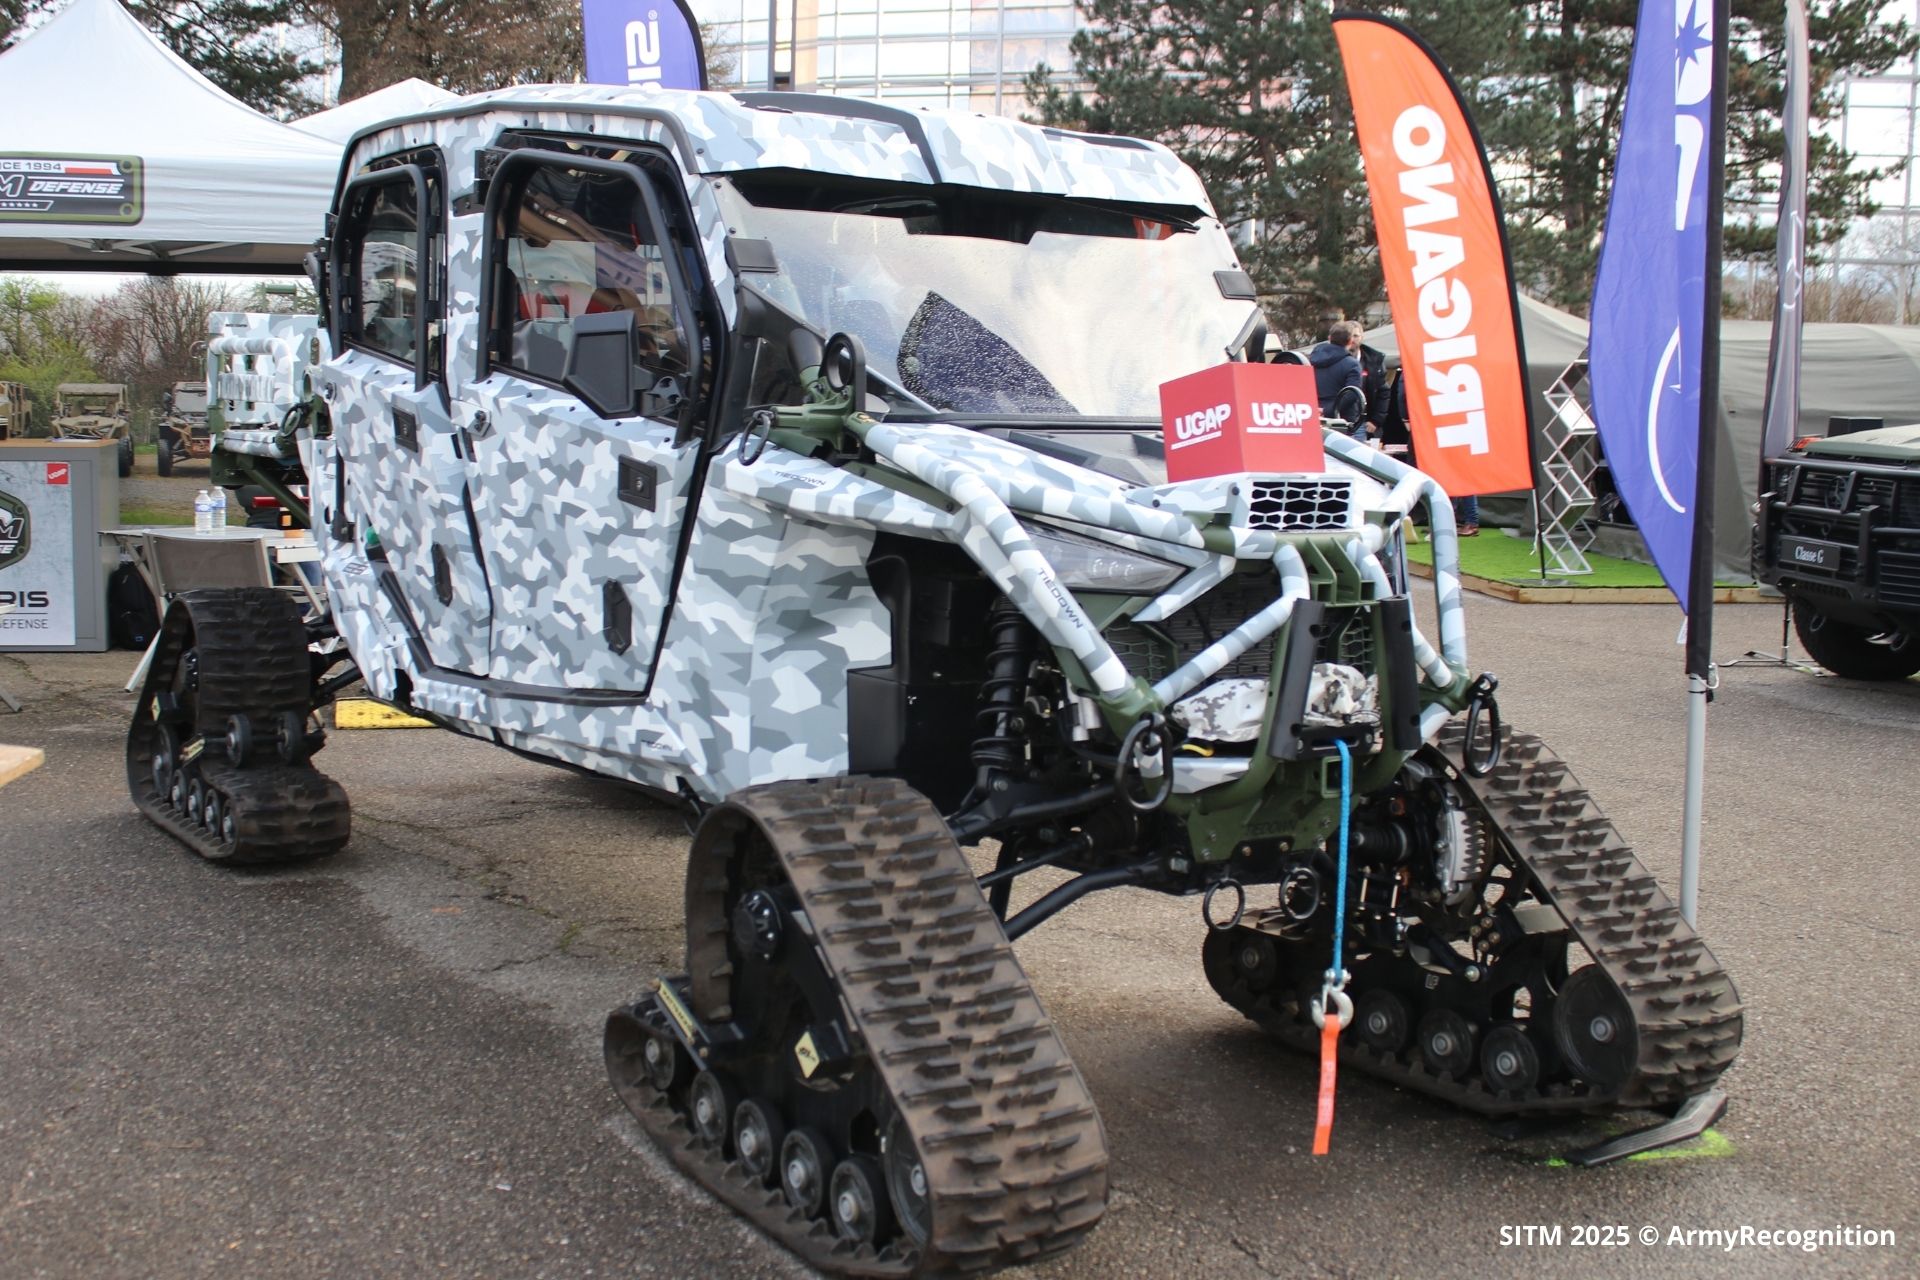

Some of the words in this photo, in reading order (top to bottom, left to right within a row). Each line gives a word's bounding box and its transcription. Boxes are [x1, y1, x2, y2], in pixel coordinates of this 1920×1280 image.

[26, 162, 61, 171] 1994
[29, 181, 123, 195] DEFENSE
[1175, 403, 1232, 440] UGAP
[1251, 402, 1313, 427] UGAP
[775, 470, 826, 486] TIEDOWN
[1037, 567, 1084, 629] TIEDOWN
[0, 619, 48, 629] EFENSE
